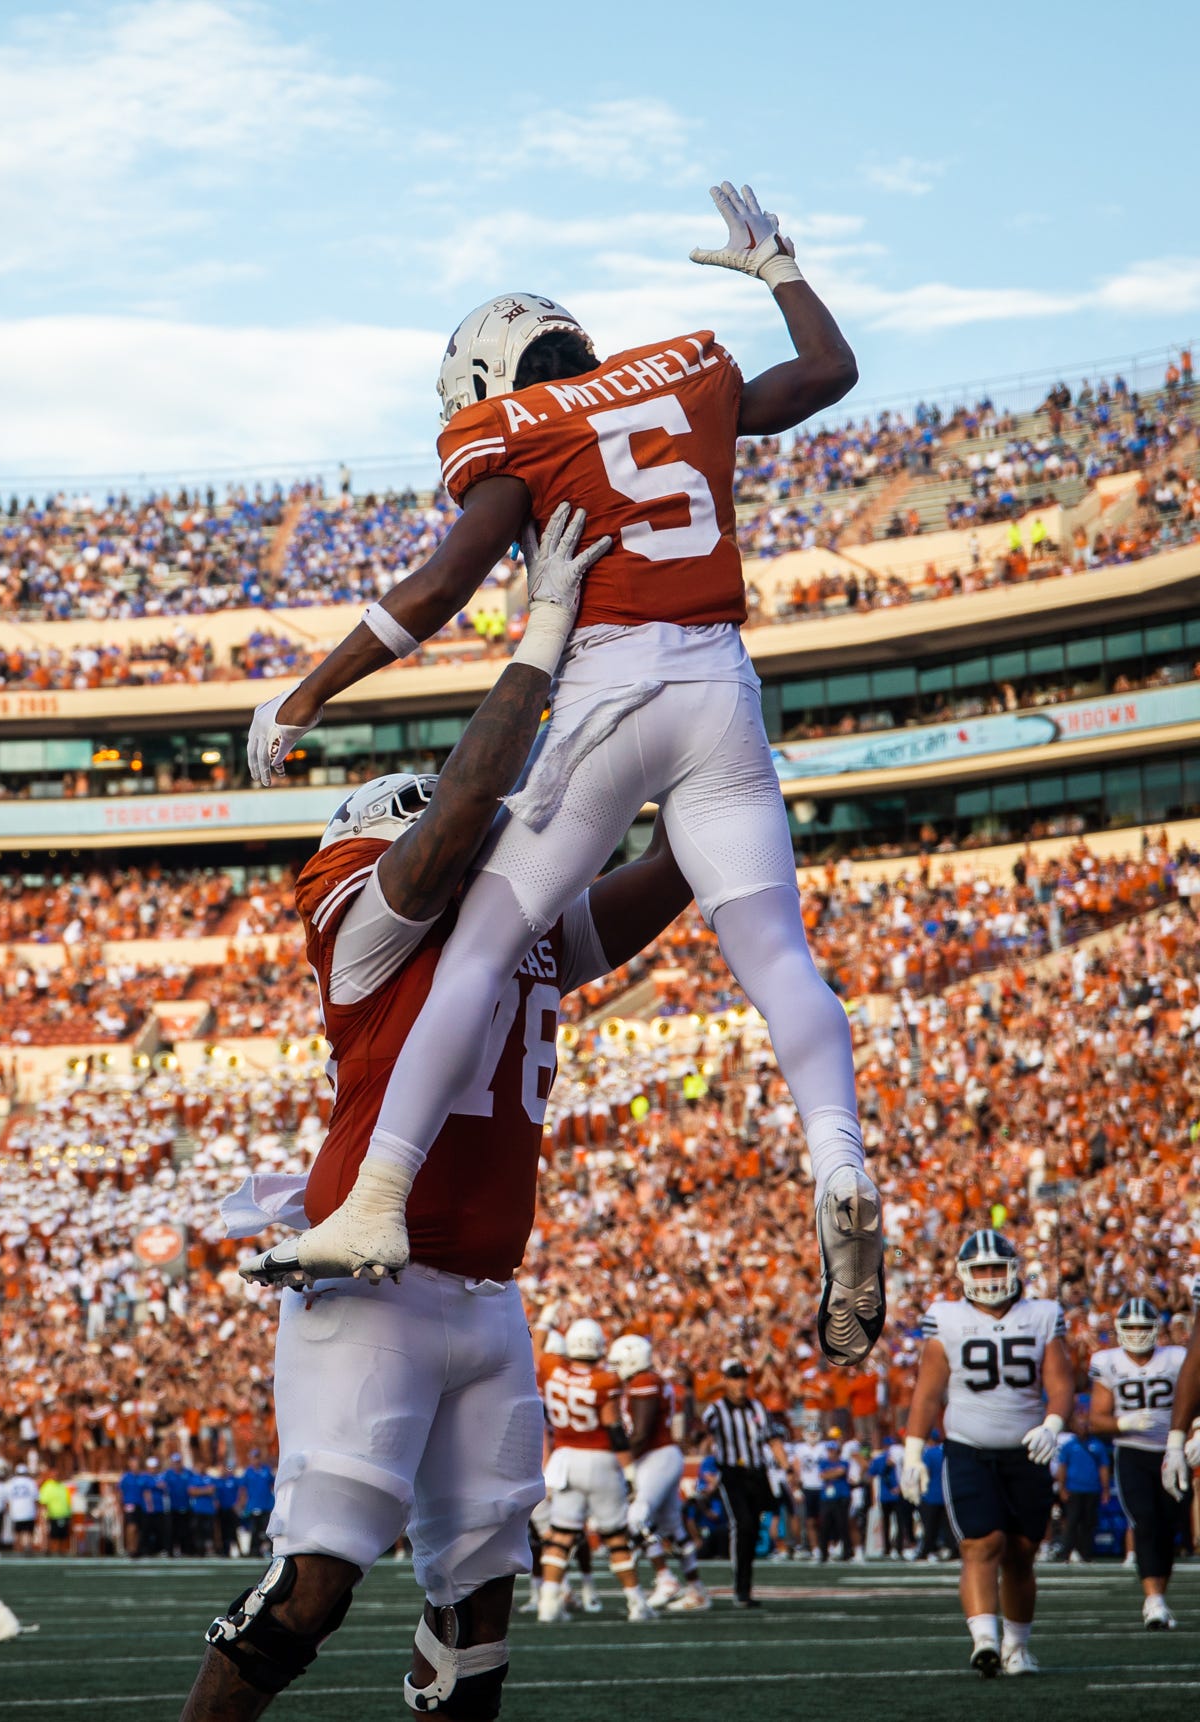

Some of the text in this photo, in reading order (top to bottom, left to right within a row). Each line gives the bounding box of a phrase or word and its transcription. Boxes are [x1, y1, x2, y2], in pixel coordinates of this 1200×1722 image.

[501, 337, 719, 433] A. MITCHELL
[586, 393, 722, 562] 5
[103, 801, 230, 826] TOUCHDOWN
[961, 1336, 1037, 1392] 95
[544, 1380, 599, 1432] 65
[1119, 1378, 1174, 1411] 92
